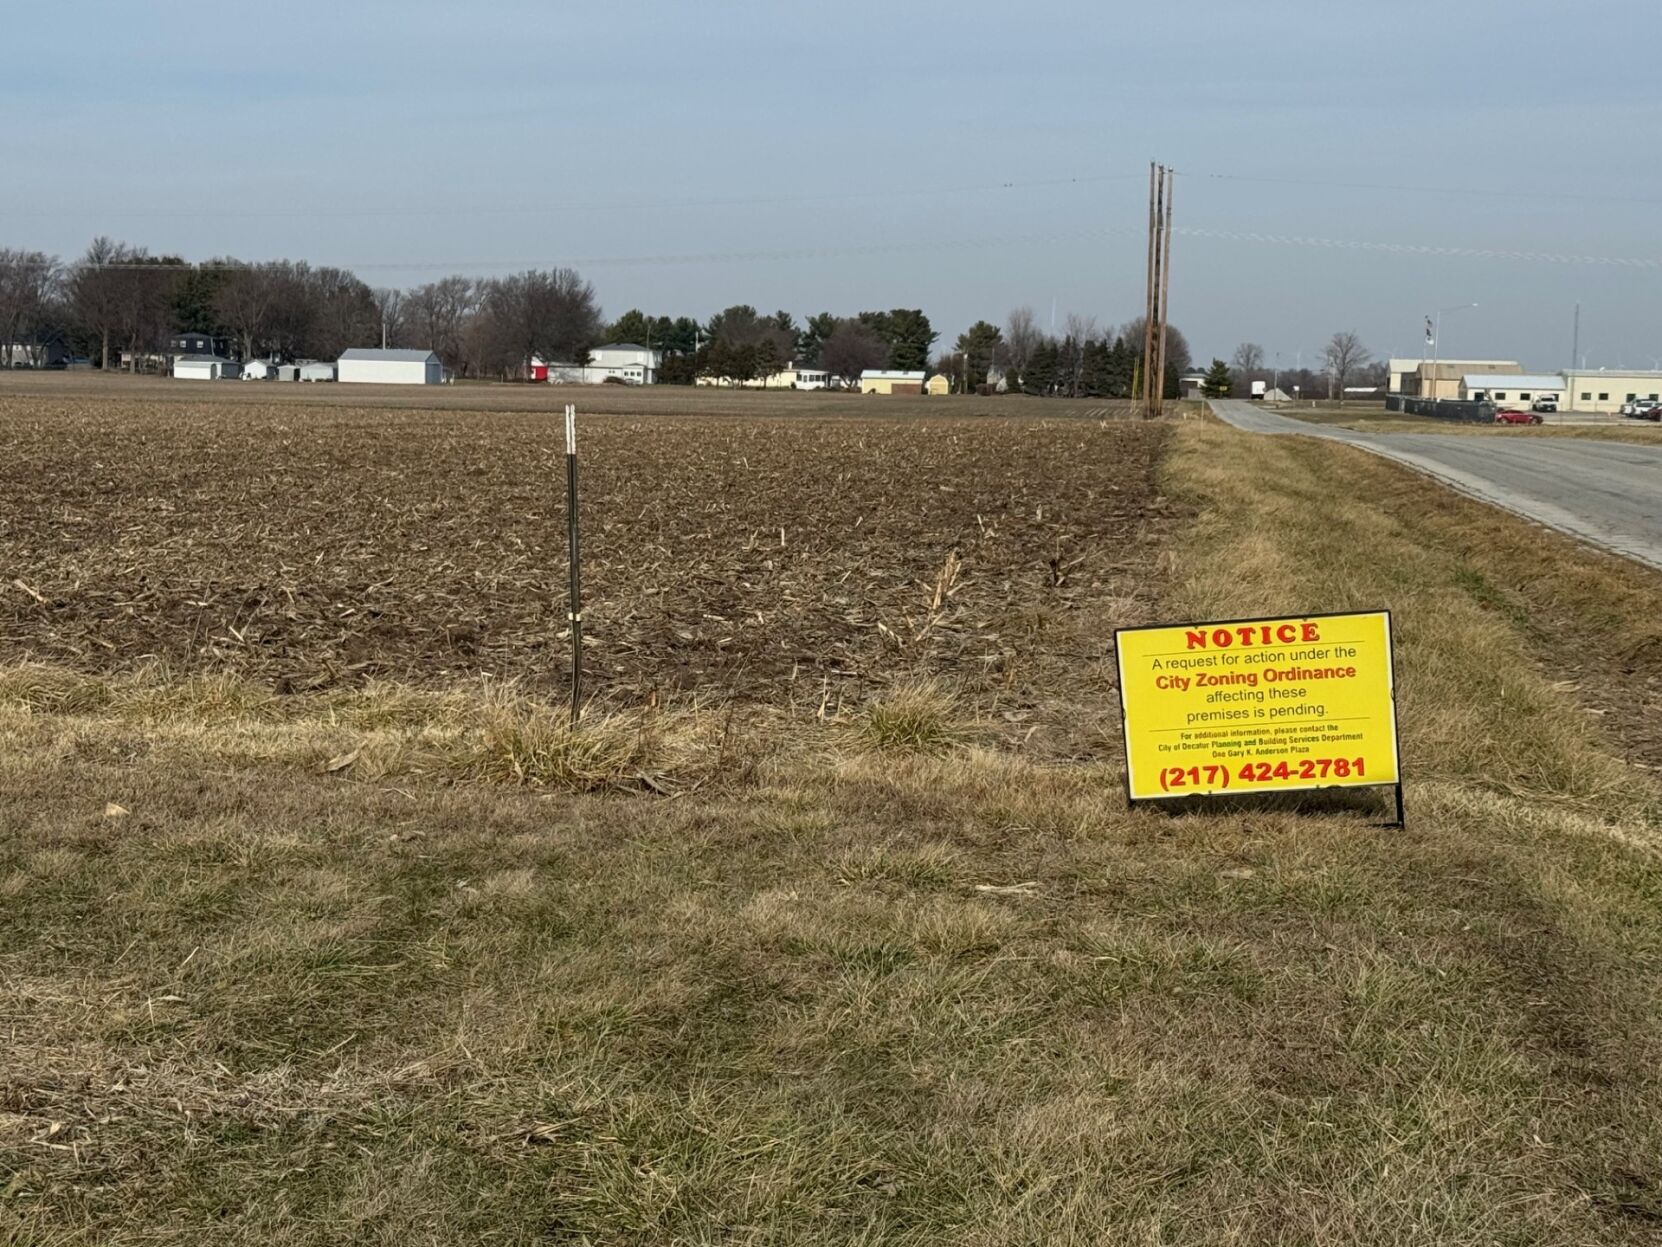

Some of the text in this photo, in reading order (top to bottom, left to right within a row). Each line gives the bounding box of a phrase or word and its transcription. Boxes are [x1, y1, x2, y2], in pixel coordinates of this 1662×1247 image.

[1186, 623, 1321, 649] NOTICE
[1152, 646, 1356, 670] A request for action under the
[1156, 665, 1356, 692] City Zoning Ordinance
[1206, 688, 1307, 703] affecting these
[1187, 703, 1328, 724] premises is pending.
[1158, 744, 1171, 752] City
[1182, 742, 1209, 750] Decatur
[1212, 740, 1242, 749] Planning
[1244, 739, 1256, 747] and
[1258, 737, 1287, 746] Building
[1289, 735, 1319, 743] Services
[1321, 733, 1363, 742] Department
[1194, 730, 1228, 739] additional
[1230, 729, 1272, 738] information,
[1274, 727, 1298, 735] please
[1299, 725, 1325, 733] contact
[1212, 750, 1225, 758] One
[1228, 749, 1244, 758] Gary
[1255, 747, 1288, 756] Anderson
[1290, 746, 1309, 754] Plaza
[1160, 758, 1365, 791] (217) 424-2781
